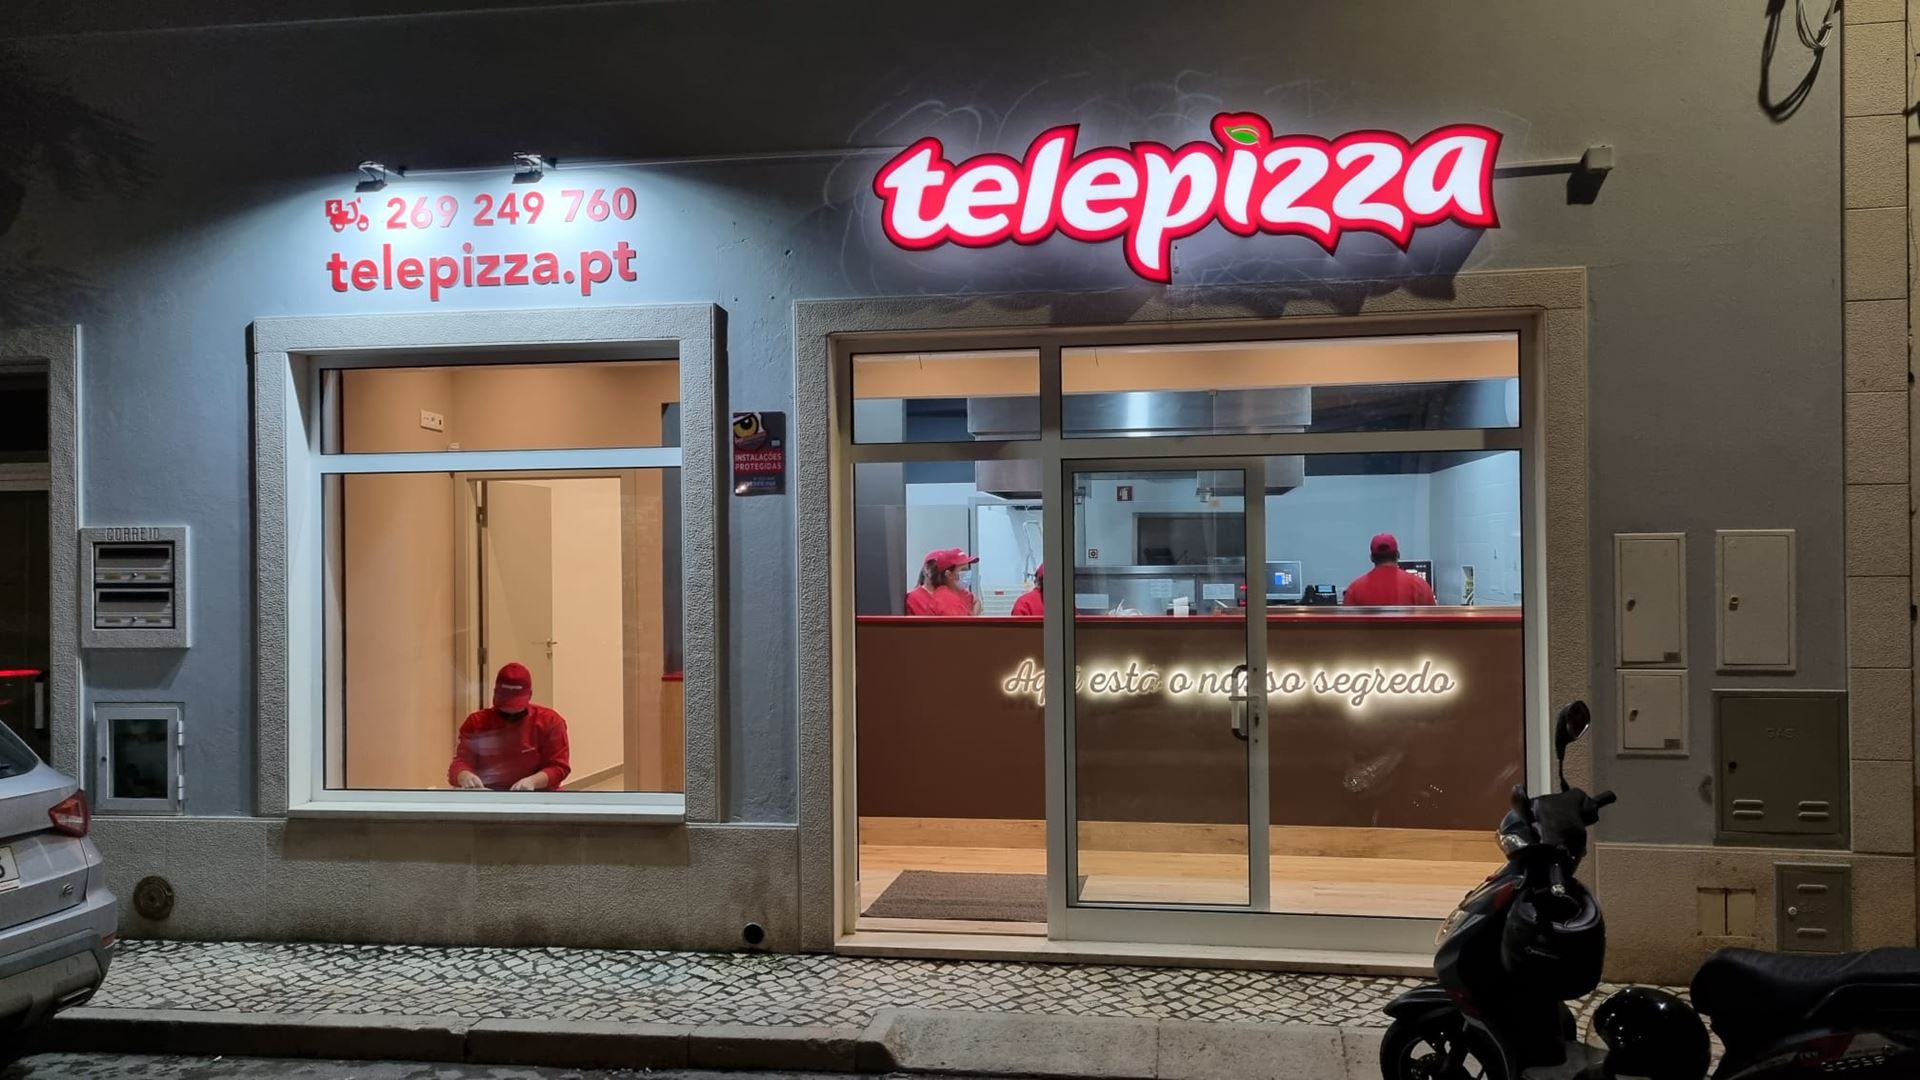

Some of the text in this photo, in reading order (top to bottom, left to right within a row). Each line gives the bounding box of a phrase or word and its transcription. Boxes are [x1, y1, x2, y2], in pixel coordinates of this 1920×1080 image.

[386, 186, 637, 229] 269 249 760
[880, 119, 1490, 274] telepizza
[326, 241, 637, 301] telepizza.pt
[735, 452, 782, 461] INSTALAÇÕES
[735, 462, 782, 471] PROTEGIDAS
[105, 527, 160, 540] CORREIO
[1003, 659, 1455, 706] Aqi está o noso segredo
